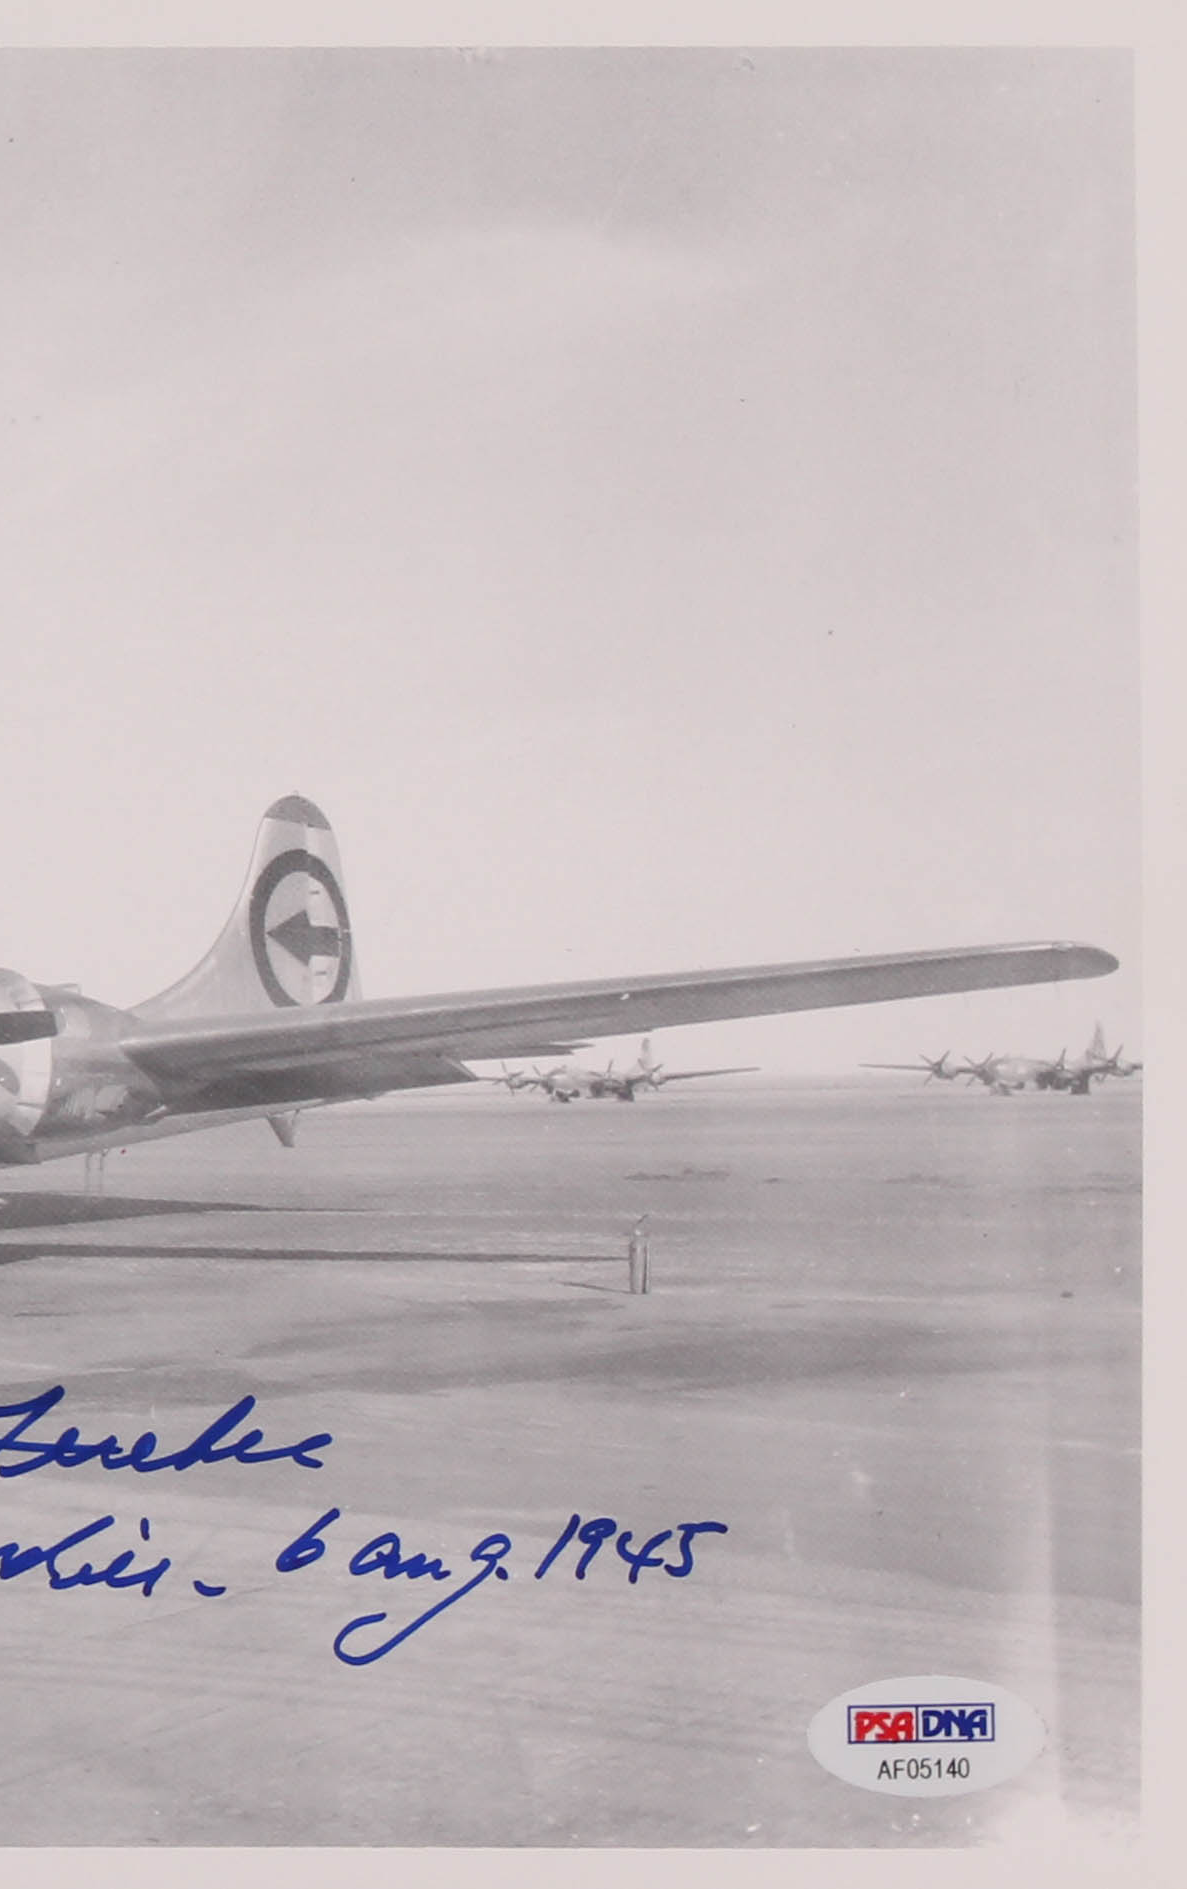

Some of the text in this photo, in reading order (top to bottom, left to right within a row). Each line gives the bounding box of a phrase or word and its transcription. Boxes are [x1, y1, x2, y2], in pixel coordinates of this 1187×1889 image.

[277, 1509, 340, 1572] 6
[536, 1514, 728, 1584] 1945
[854, 1709, 988, 1742] PSA DNA
[877, 1757, 970, 1780] AF05140
